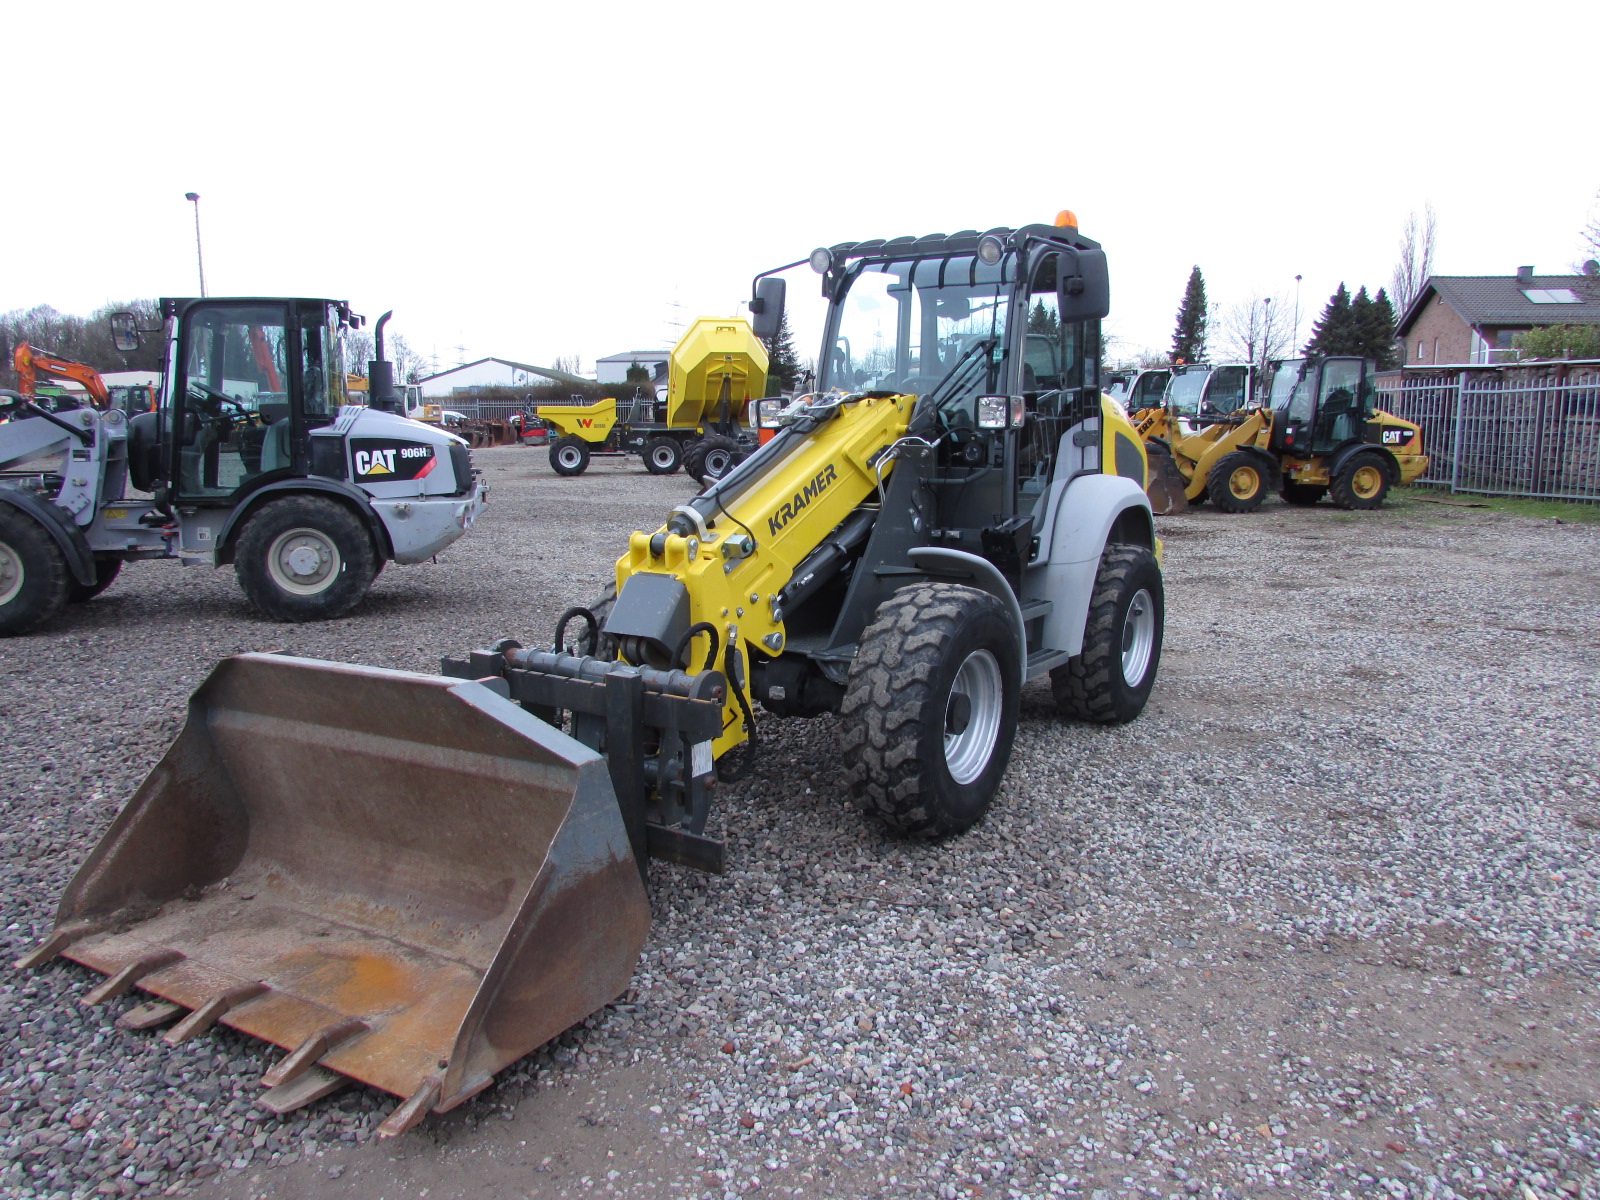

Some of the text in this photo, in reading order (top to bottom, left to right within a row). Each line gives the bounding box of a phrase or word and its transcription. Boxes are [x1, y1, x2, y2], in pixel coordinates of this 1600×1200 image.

[1382, 430, 1401, 444] CAT
[355, 448, 397, 475] CAT
[767, 463, 838, 538] KRAMER
